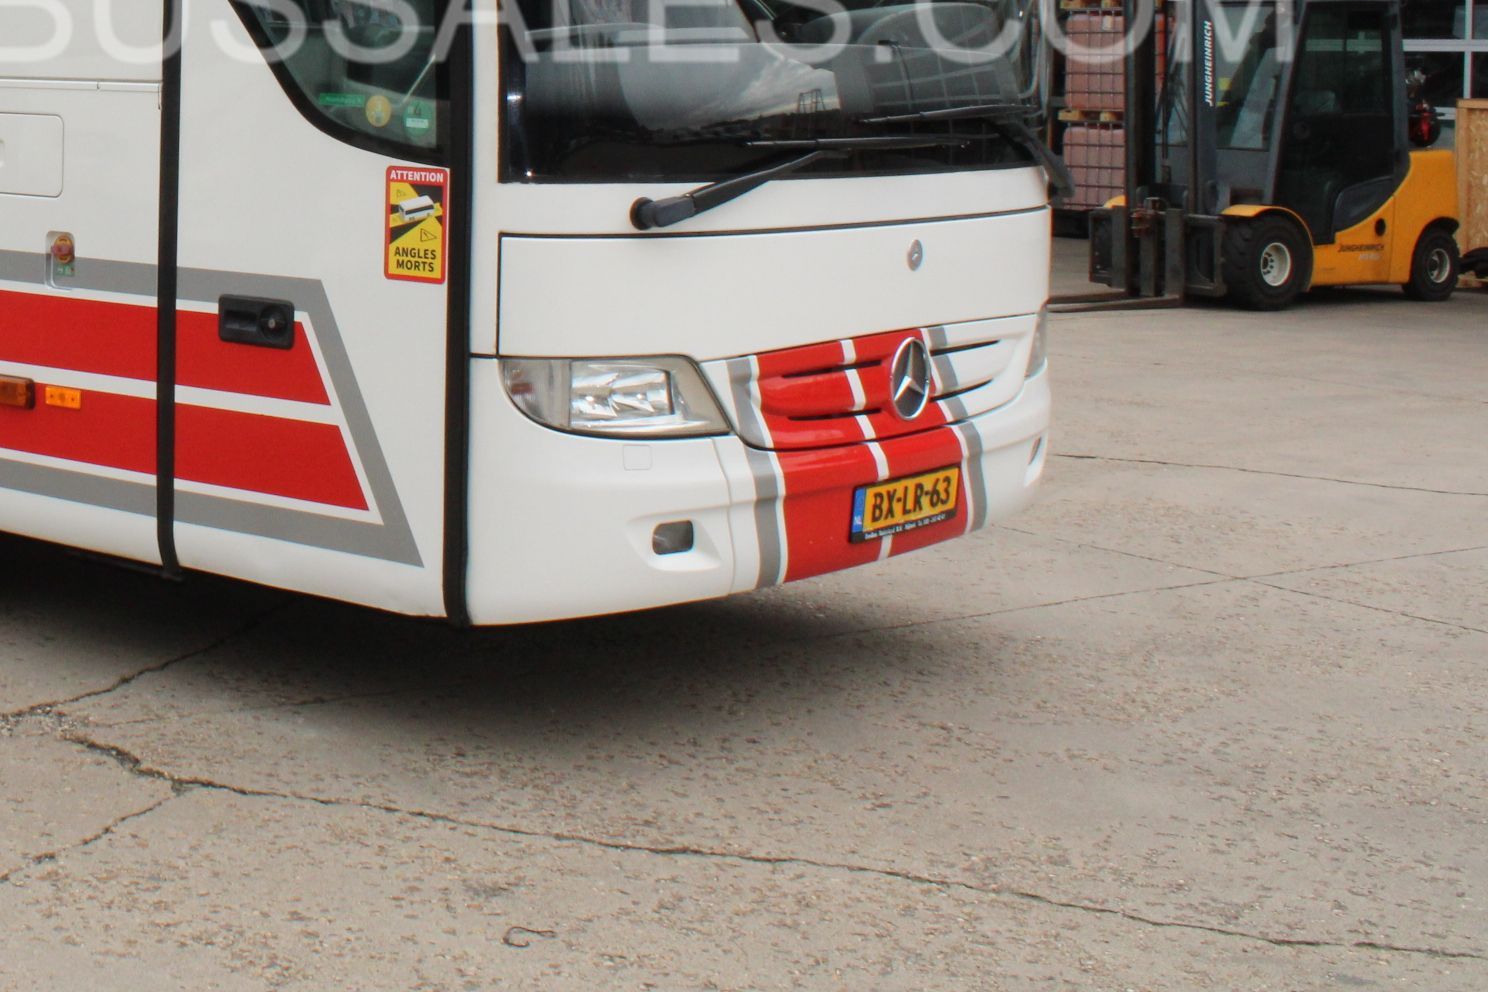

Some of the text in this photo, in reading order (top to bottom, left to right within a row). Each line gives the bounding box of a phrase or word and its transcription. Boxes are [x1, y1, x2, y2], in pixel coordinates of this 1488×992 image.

[1204, 20, 1214, 107] JUNGHEINRICH
[390, 170, 443, 182] ATTENTION
[394, 246, 437, 260] ANGLES
[396, 259, 435, 273] MORTS
[872, 476, 952, 523] BX-LR-63
